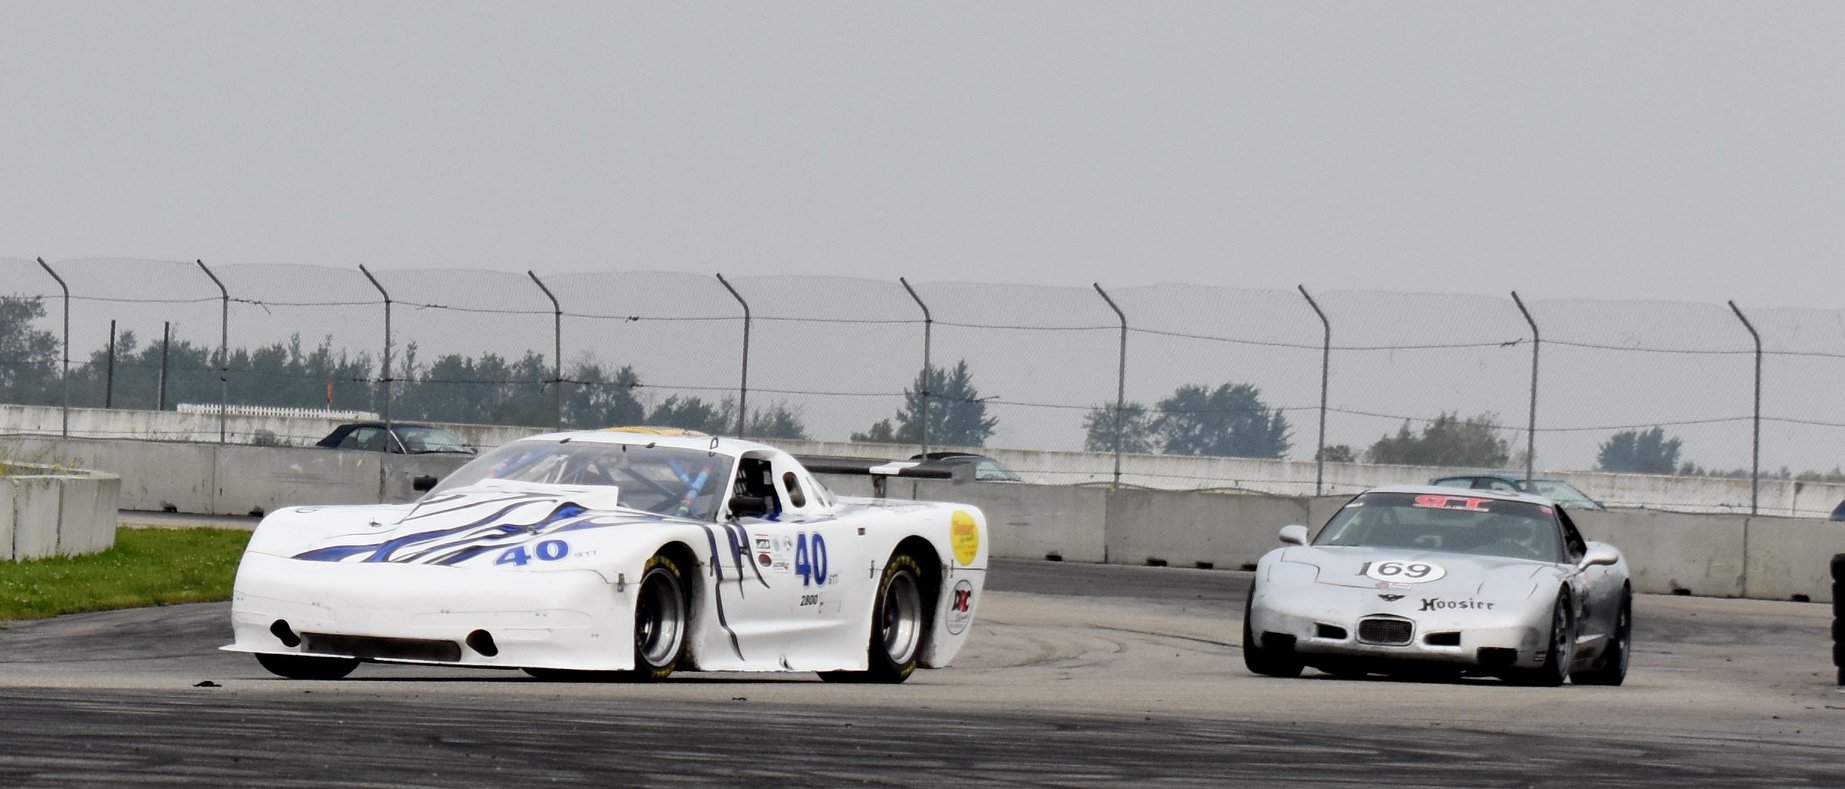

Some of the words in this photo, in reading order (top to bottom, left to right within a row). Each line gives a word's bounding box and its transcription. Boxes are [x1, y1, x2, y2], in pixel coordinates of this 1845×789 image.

[495, 539, 569, 566] 40
[795, 532, 828, 586] 40
[1355, 561, 1432, 578] 169
[800, 594, 819, 606] 2800
[1418, 597, 1494, 611] Hoosier
